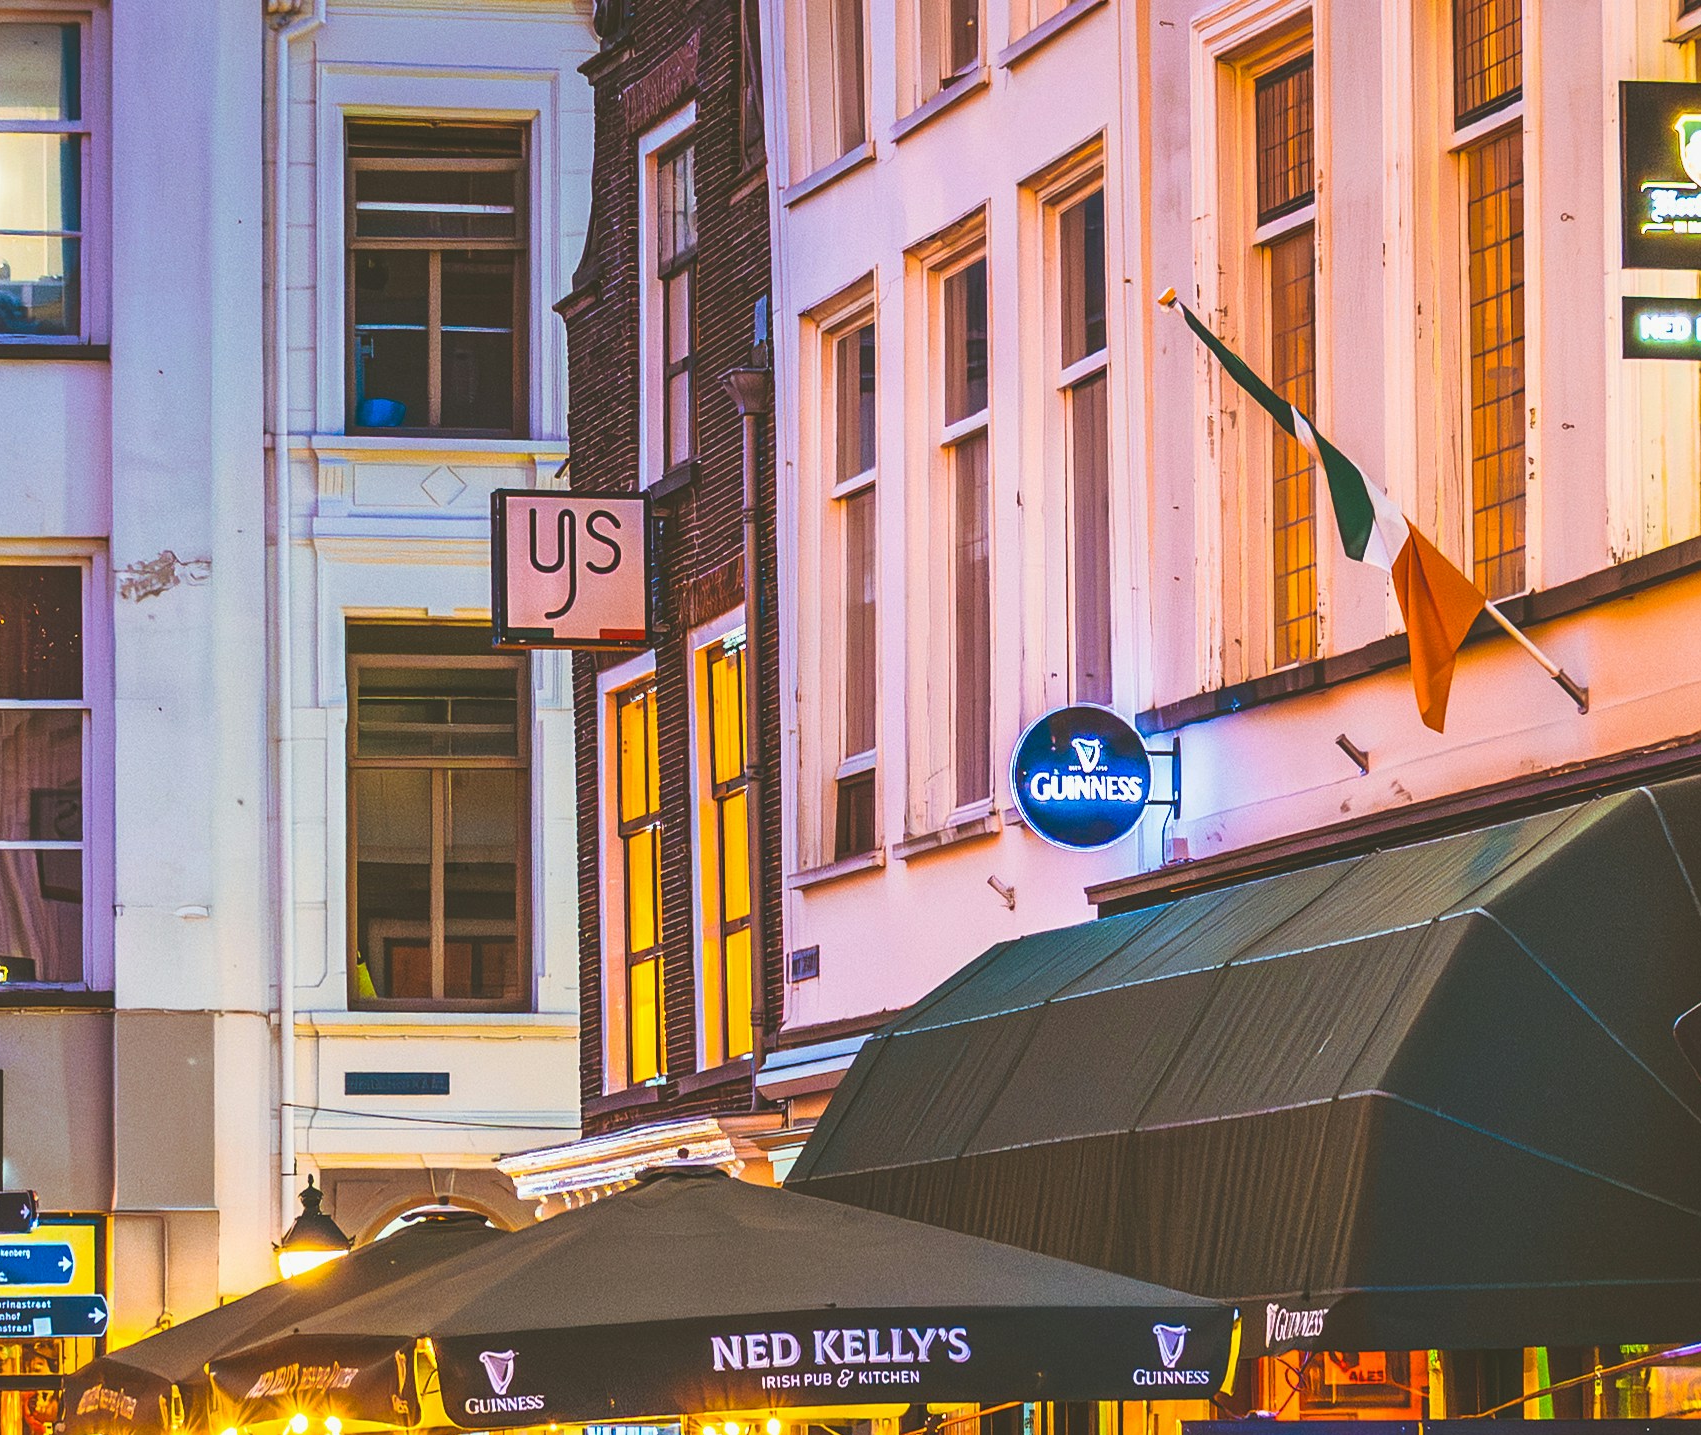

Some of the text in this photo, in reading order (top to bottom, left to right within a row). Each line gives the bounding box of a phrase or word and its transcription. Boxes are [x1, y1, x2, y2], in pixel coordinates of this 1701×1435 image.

[1640, 315, 1692, 341] NED
[1030, 772, 1142, 802] GUINNESS
[710, 1326, 972, 1372] NED KELLY'S
[761, 1368, 921, 1390] IRISH PUB & KITCHEN
[1132, 1368, 1209, 1386] GUINNESS
[465, 1394, 545, 1415] GUINNESS
